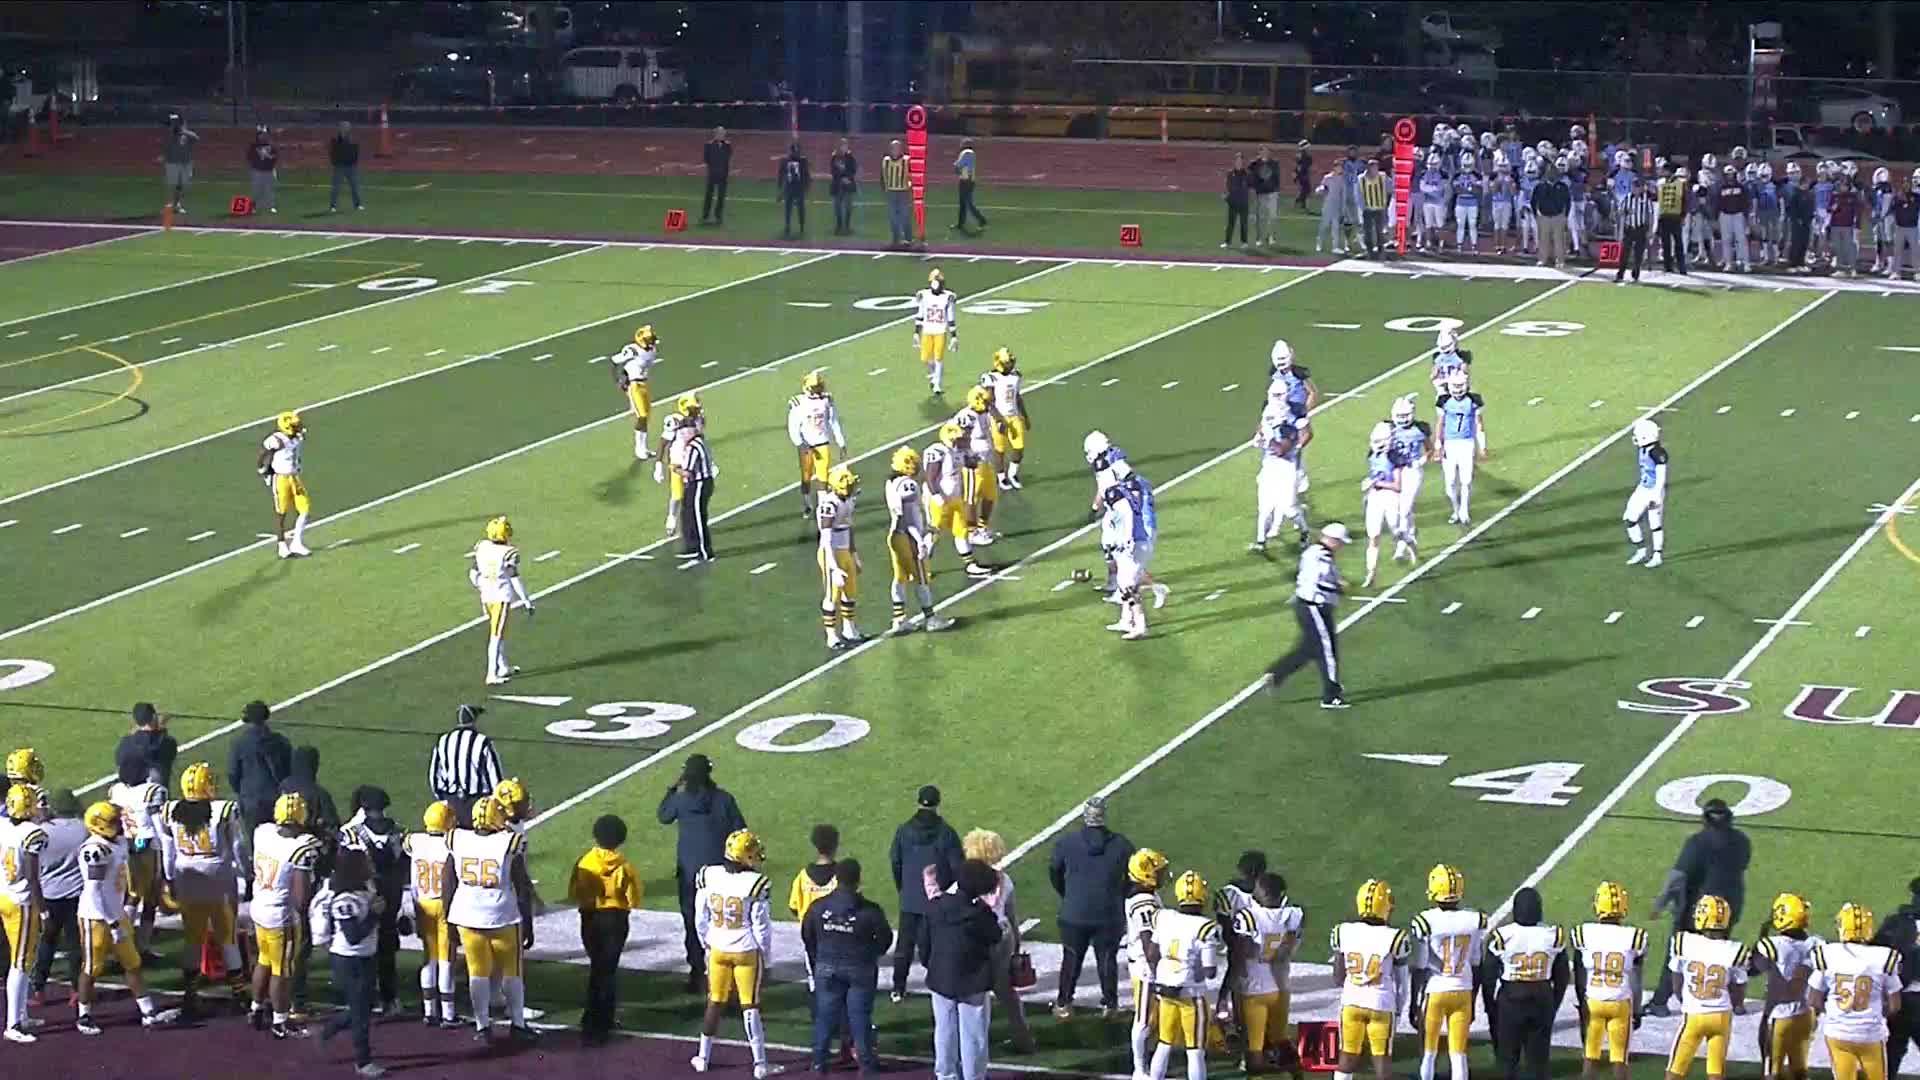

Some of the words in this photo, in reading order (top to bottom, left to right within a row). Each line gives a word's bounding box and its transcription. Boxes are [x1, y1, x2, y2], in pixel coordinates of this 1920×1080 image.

[667, 211, 682, 227] 10
[1121, 226, 1138, 242] 20
[1601, 243, 1620, 261] 30
[1456, 412, 1465, 433] 7
[461, 857, 499, 888] 56
[1439, 933, 1471, 976] 17
[1345, 951, 1382, 987] 24
[1687, 960, 1728, 1000] 32
